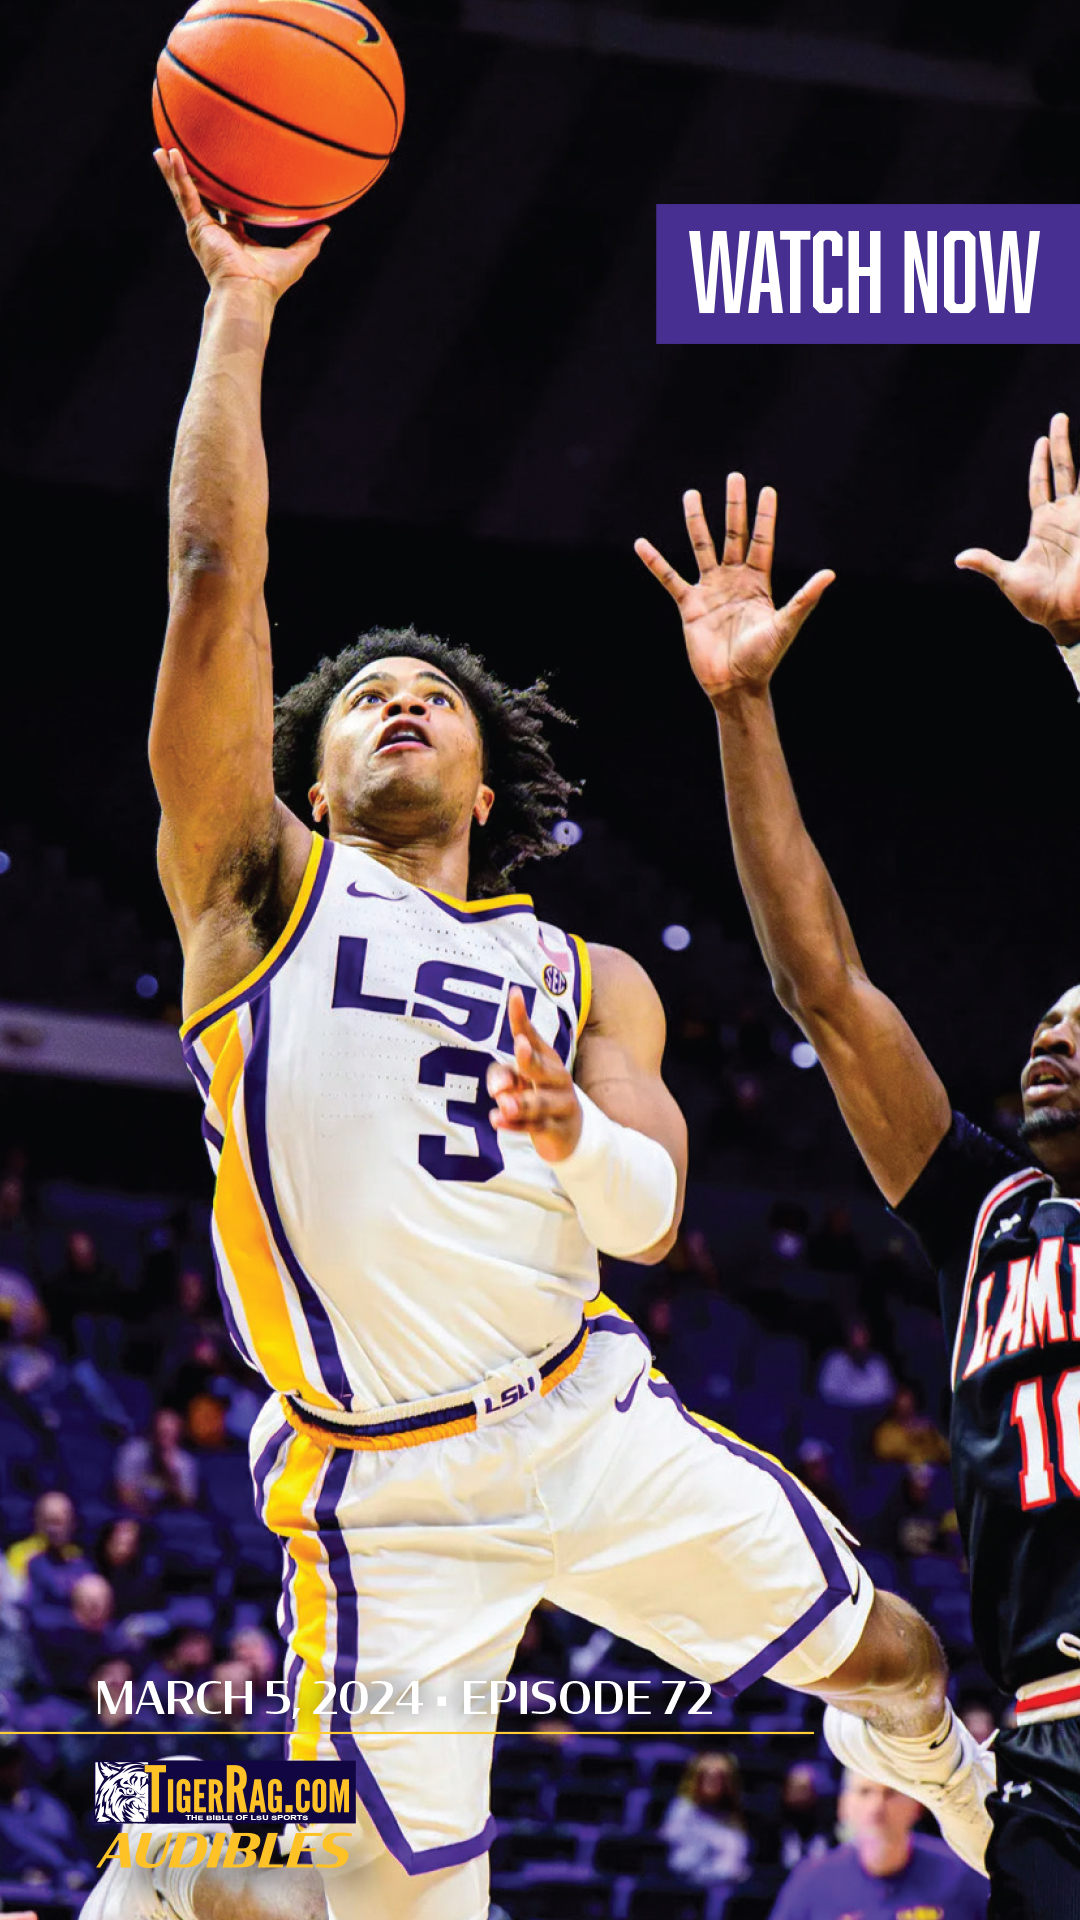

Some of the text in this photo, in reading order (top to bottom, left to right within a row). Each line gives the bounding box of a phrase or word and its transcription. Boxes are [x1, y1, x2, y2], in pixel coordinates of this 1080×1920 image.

[545, 966, 566, 993] SEC
[418, 1045, 505, 1183] 3
[962, 1236, 1080, 1381] LAM
[484, 1375, 536, 1414] LSU
